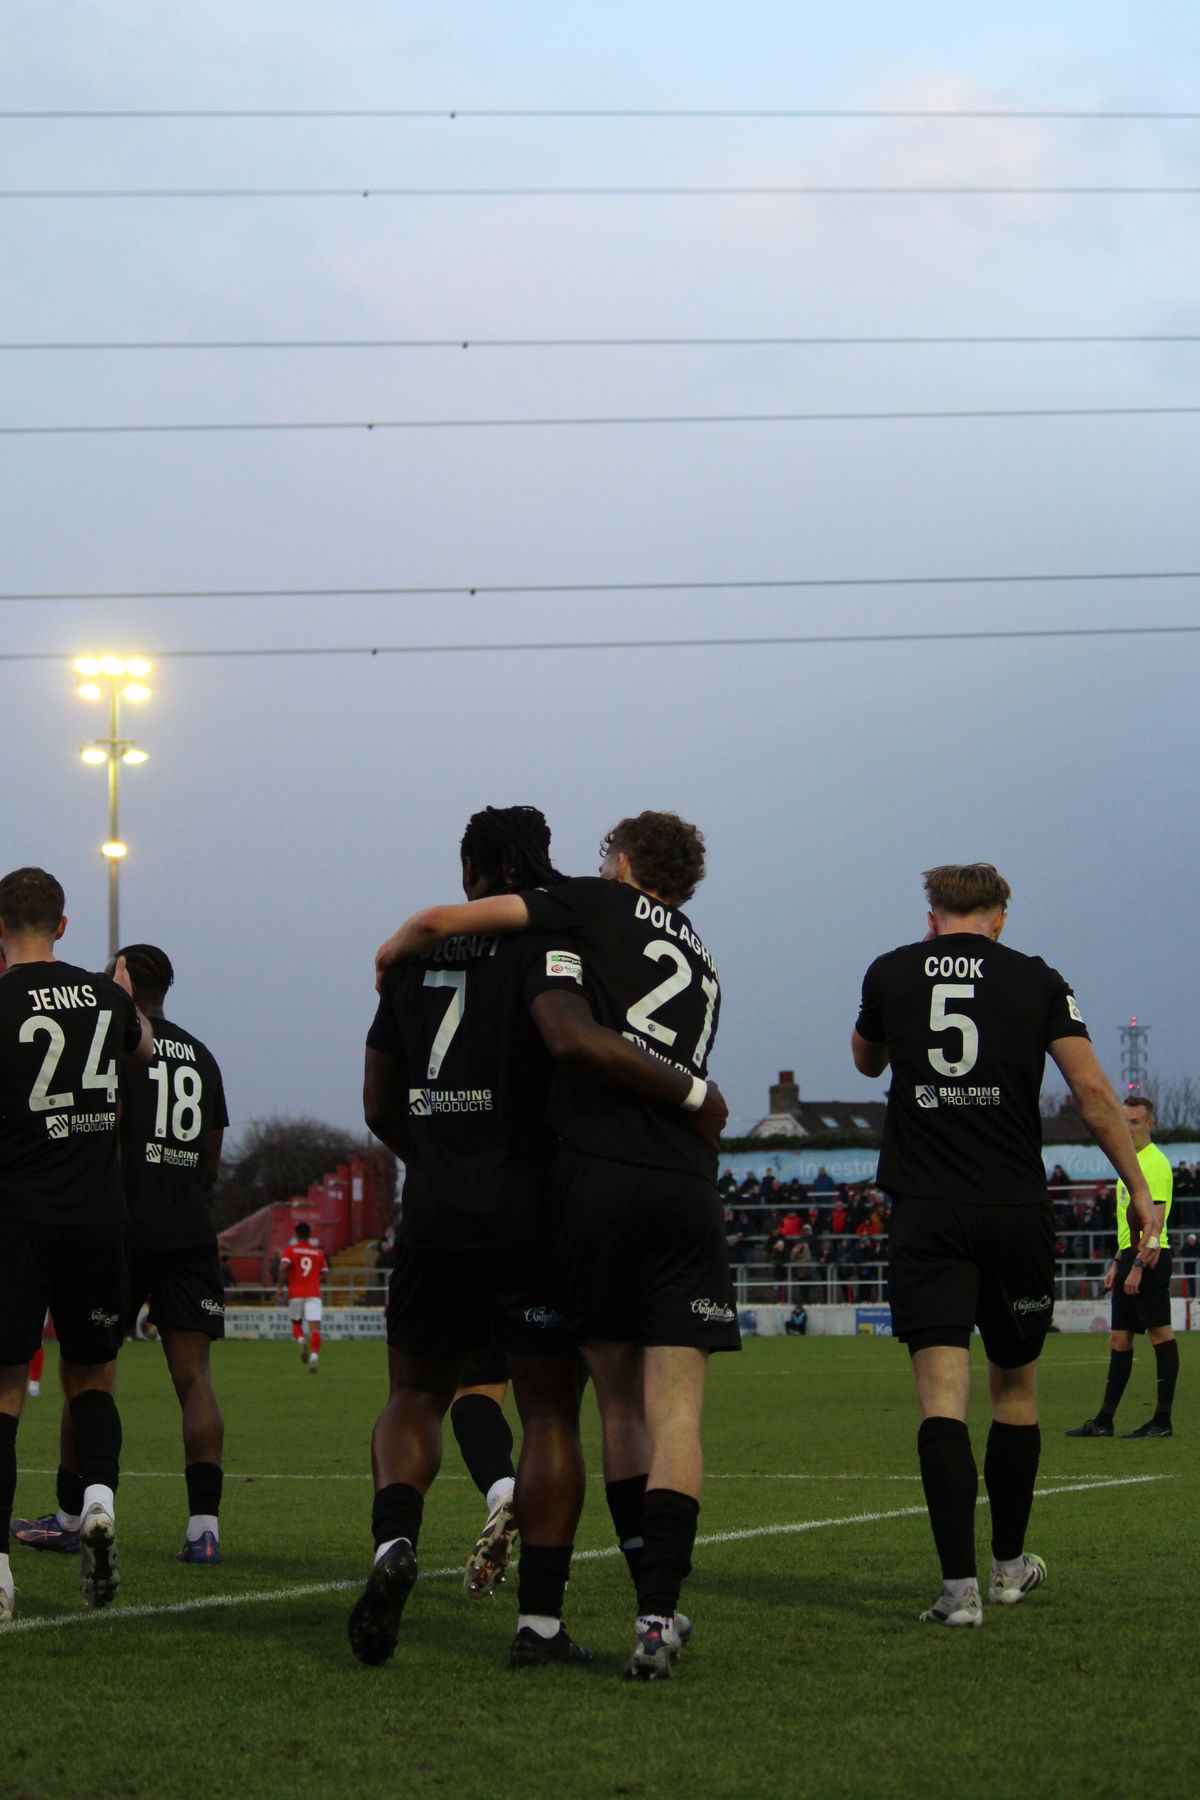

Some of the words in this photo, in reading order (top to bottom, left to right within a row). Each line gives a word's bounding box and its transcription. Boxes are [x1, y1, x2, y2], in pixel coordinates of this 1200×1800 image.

[925, 956, 984, 978] COOK
[27, 984, 97, 1011] JENKS
[625, 939, 719, 1068] 21
[422, 969, 466, 1080] 7
[927, 983, 979, 1077] 5
[18, 1010, 119, 1112] 24
[148, 1060, 203, 1142] 18
[430, 1089, 492, 1102] BUILDING
[939, 1086, 1001, 1097] BUILDING
[940, 1096, 1001, 1106] PRODUCTS
[431, 1099, 494, 1113] PRODUCTS
[71, 1112, 116, 1124] BUILDING
[71, 1120, 115, 1134] PRODUCTS
[300, 1256, 313, 1278] 9
